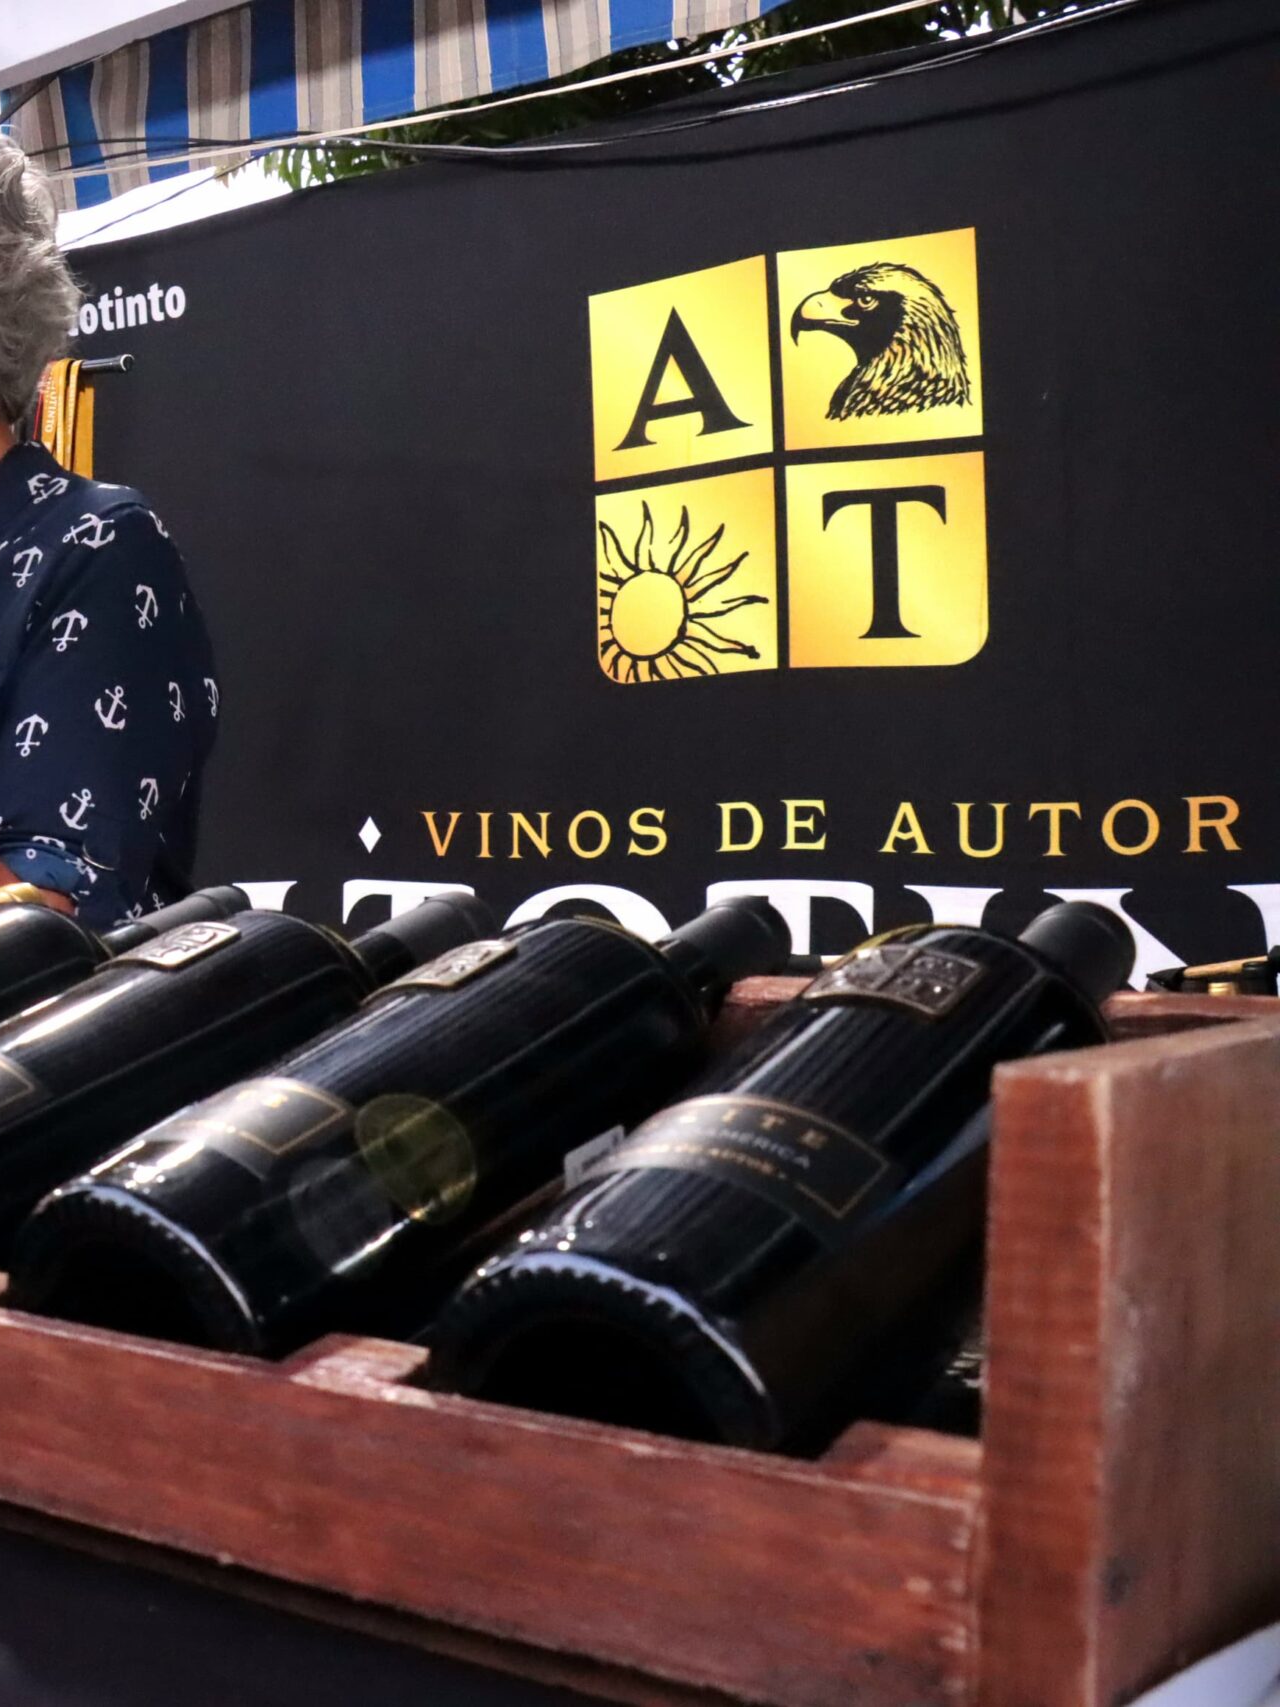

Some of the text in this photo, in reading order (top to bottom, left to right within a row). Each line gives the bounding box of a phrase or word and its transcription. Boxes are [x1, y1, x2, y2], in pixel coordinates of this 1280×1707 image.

[67, 282, 186, 337] otinto
[612, 306, 754, 452] A
[822, 485, 947, 639] T
[421, 795, 1243, 860] VINOS DE AUTOR
